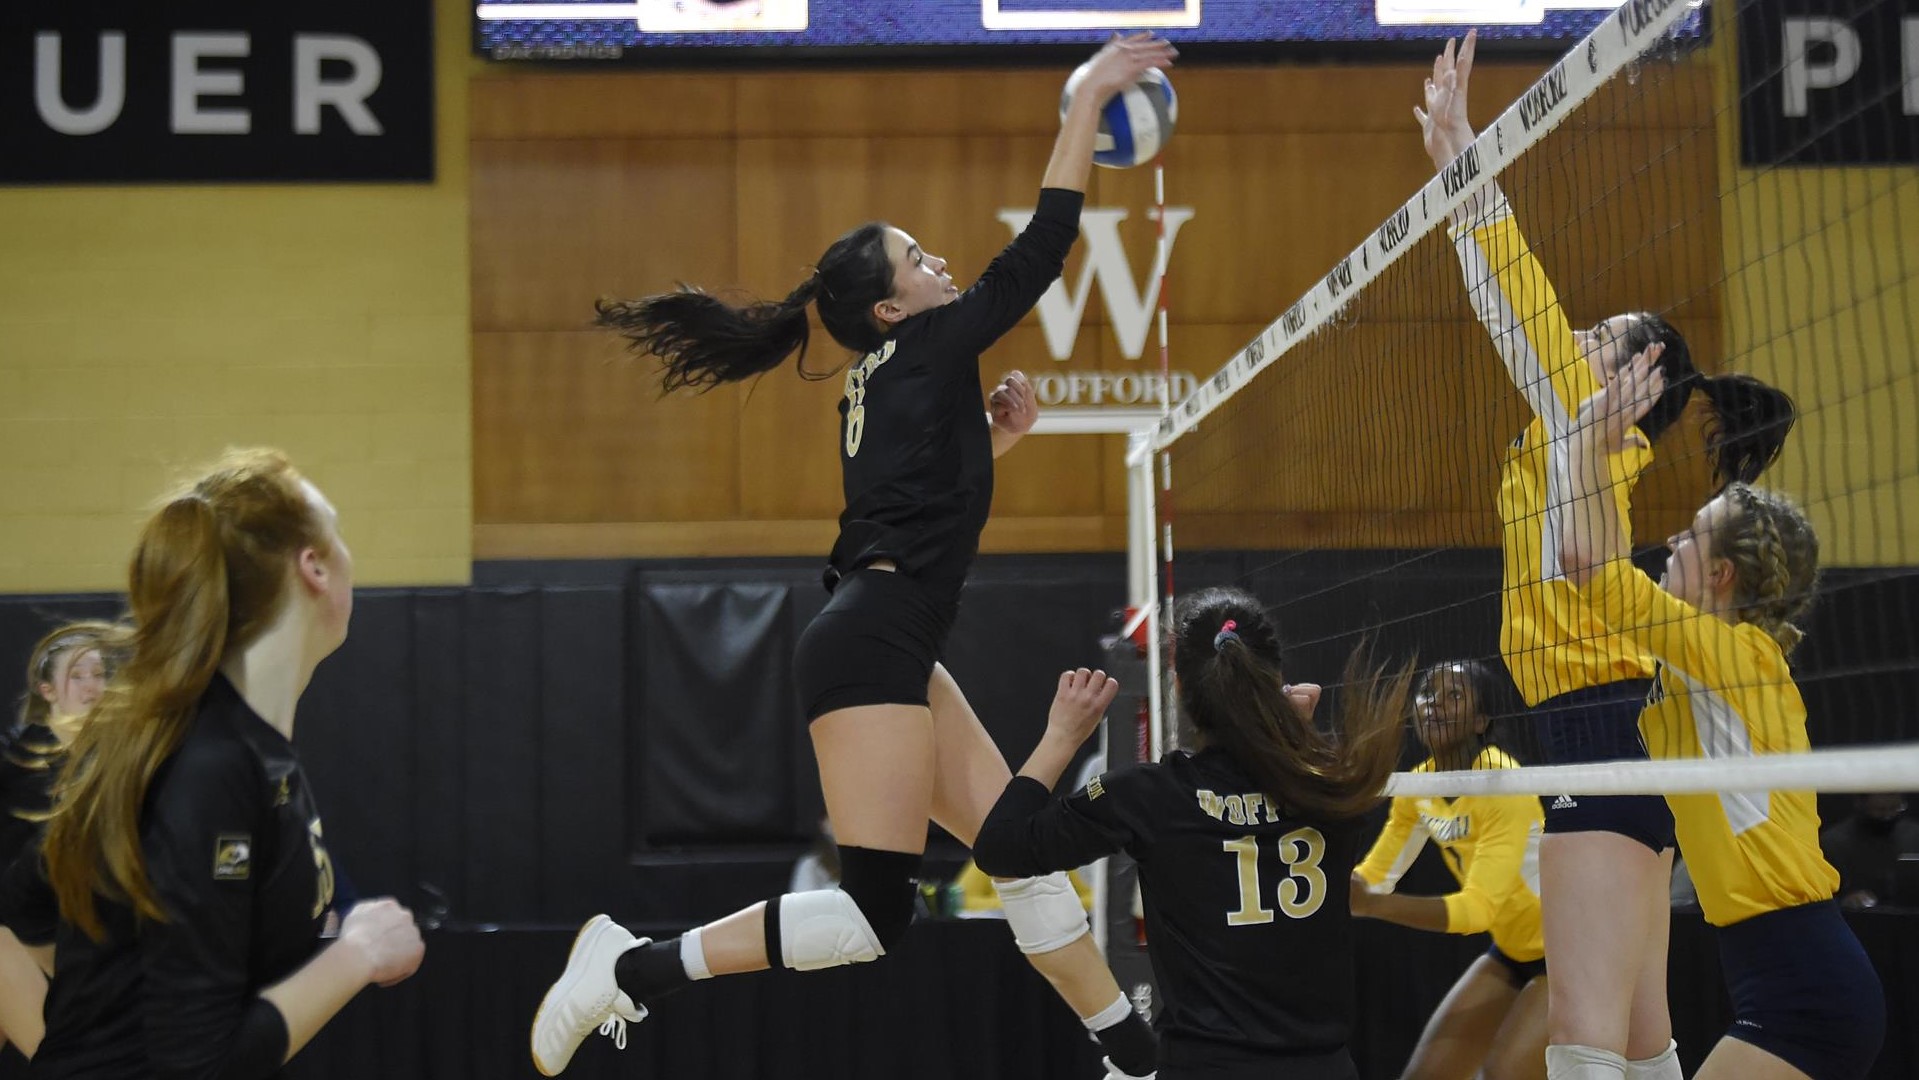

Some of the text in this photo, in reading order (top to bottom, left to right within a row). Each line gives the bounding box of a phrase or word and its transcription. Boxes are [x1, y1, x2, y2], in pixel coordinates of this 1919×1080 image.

[34, 31, 384, 136] UER
[1032, 373, 1202, 405] OFFORD
[1222, 826, 1327, 926] 13
